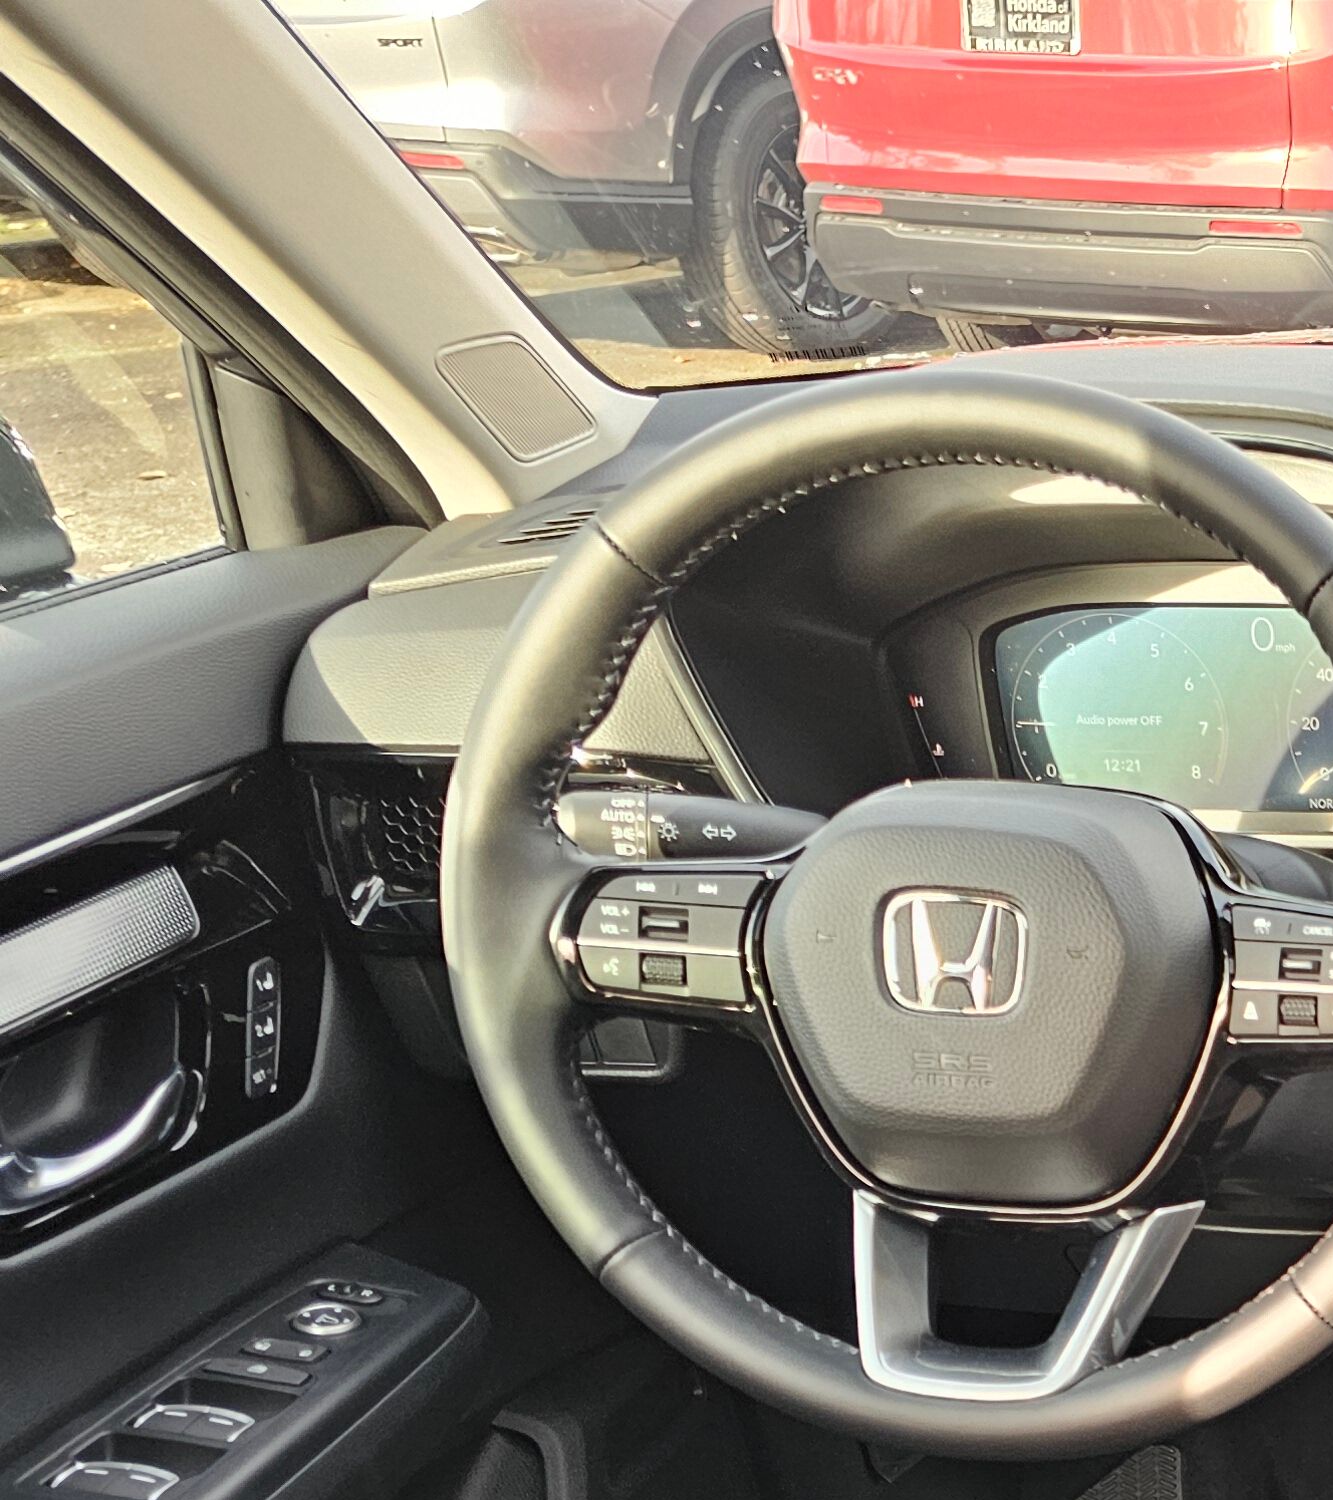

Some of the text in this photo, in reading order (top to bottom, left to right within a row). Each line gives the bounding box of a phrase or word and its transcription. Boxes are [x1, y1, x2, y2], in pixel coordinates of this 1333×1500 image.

[1007, 13, 1070, 33] Kirkland
[1107, 631, 1117, 645] 4
[1250, 616, 1296, 653] 0 mph
[1066, 642, 1076, 657] 3
[1151, 643, 1159, 657] 5
[1316, 668, 1333, 682] 40
[1184, 677, 1194, 691] 6
[1076, 714, 1163, 727] Audio power OFF
[1302, 718, 1320, 731] 20
[1199, 721, 1208, 736] 7
[1046, 763, 1057, 778] 0
[1104, 759, 1141, 772] 12:21
[1191, 765, 1201, 779] 8
[600, 808, 635, 823] AUTO
[912, 1051, 993, 1072] SRS
